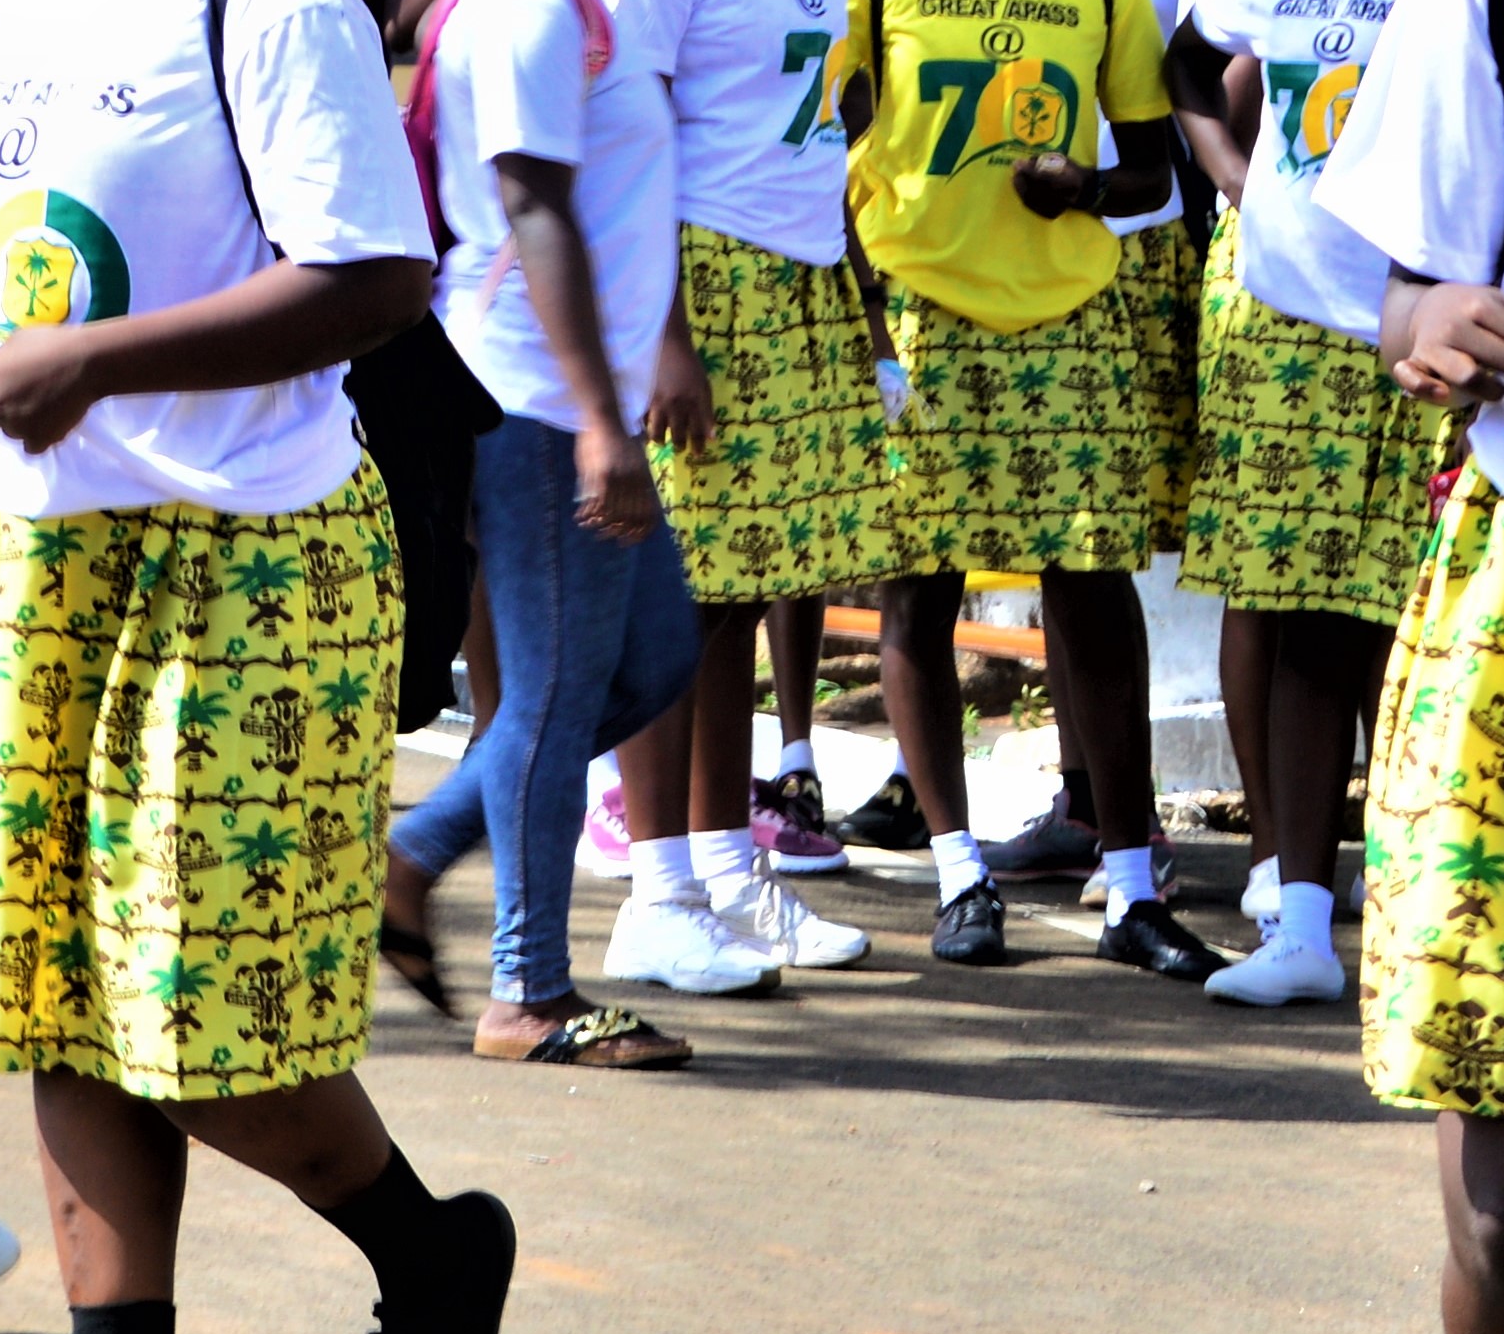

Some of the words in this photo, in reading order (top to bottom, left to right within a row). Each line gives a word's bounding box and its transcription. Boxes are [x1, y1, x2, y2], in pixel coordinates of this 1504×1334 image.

[980, 22, 1025, 63] @
[1313, 22, 1354, 63] @
[919, 58, 1079, 175] 70
